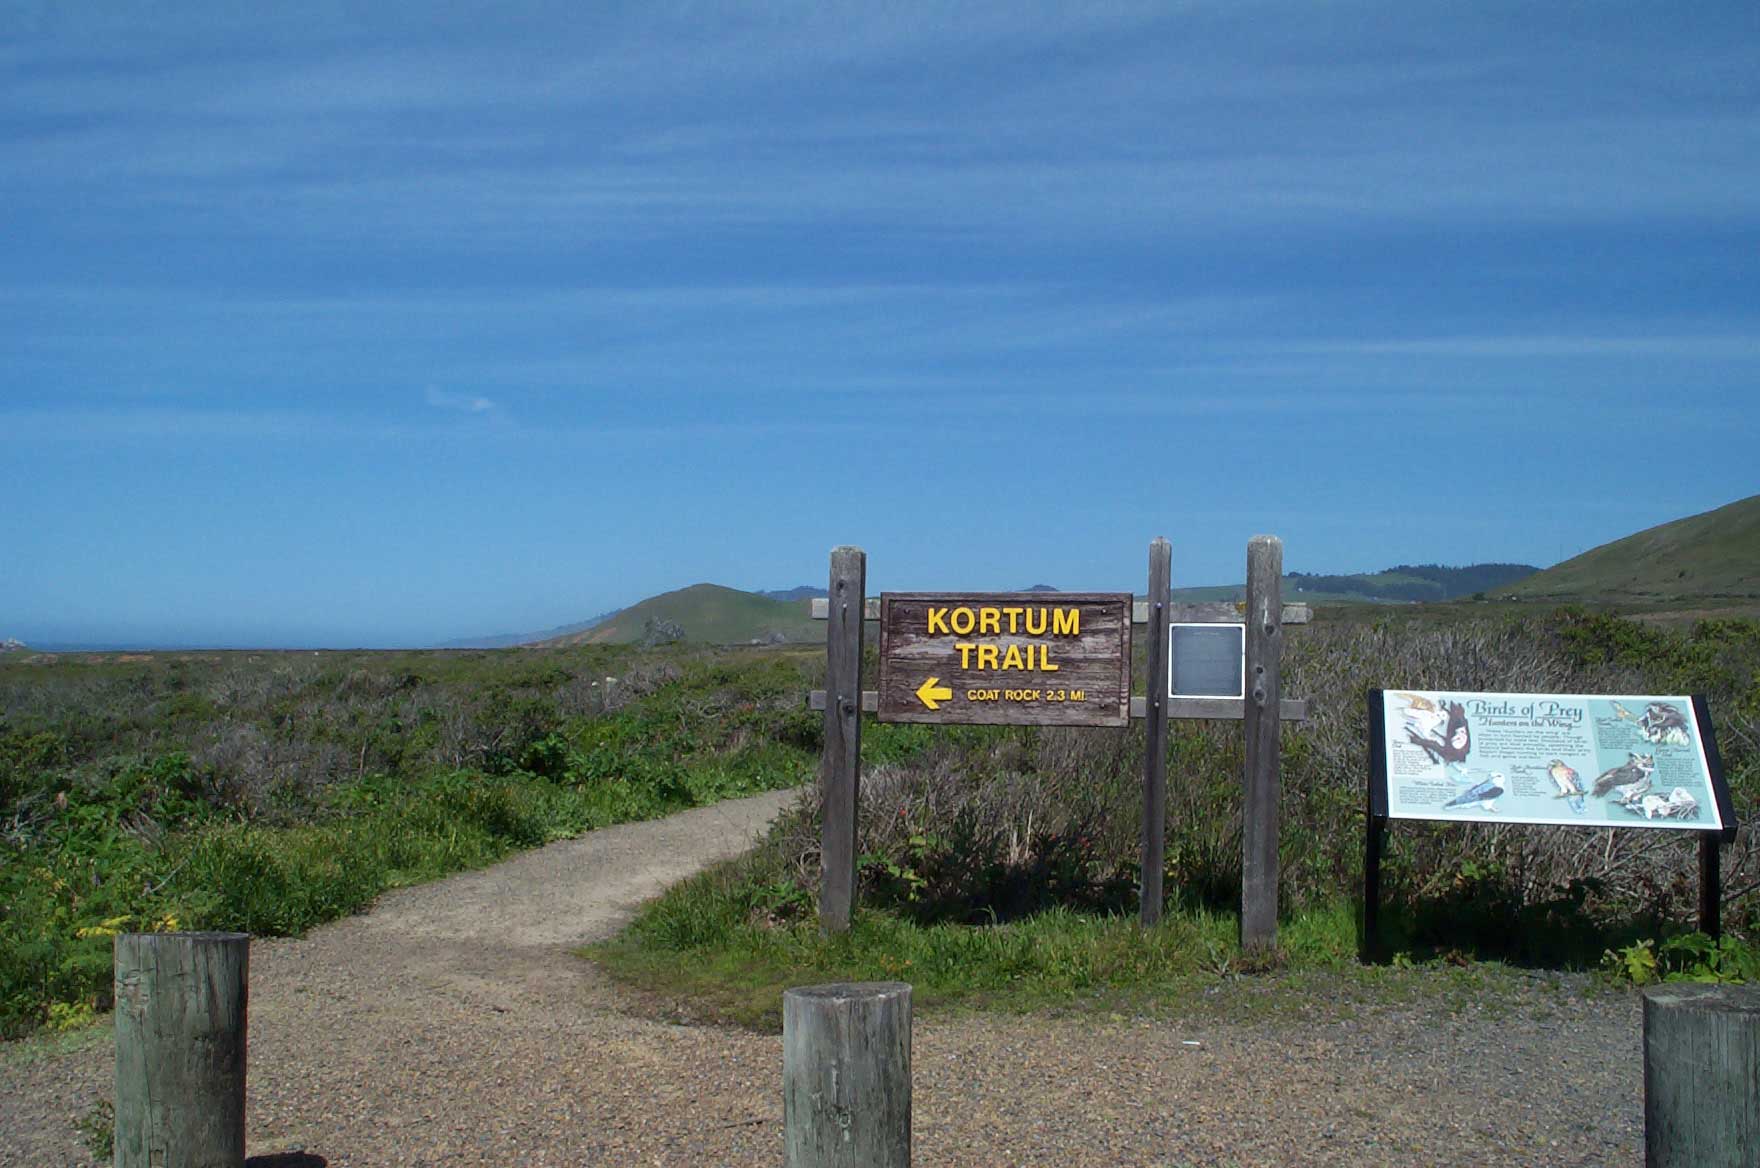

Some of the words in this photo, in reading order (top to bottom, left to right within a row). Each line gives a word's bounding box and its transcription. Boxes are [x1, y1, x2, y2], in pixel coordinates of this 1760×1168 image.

[927, 607, 1080, 635] KORTUM
[955, 643, 1059, 671] TRAIL
[1004, 689, 1040, 701] ROCK
[1467, 700, 1516, 716] Birds
[1521, 702, 1535, 719] of
[1539, 701, 1583, 722] Prey
